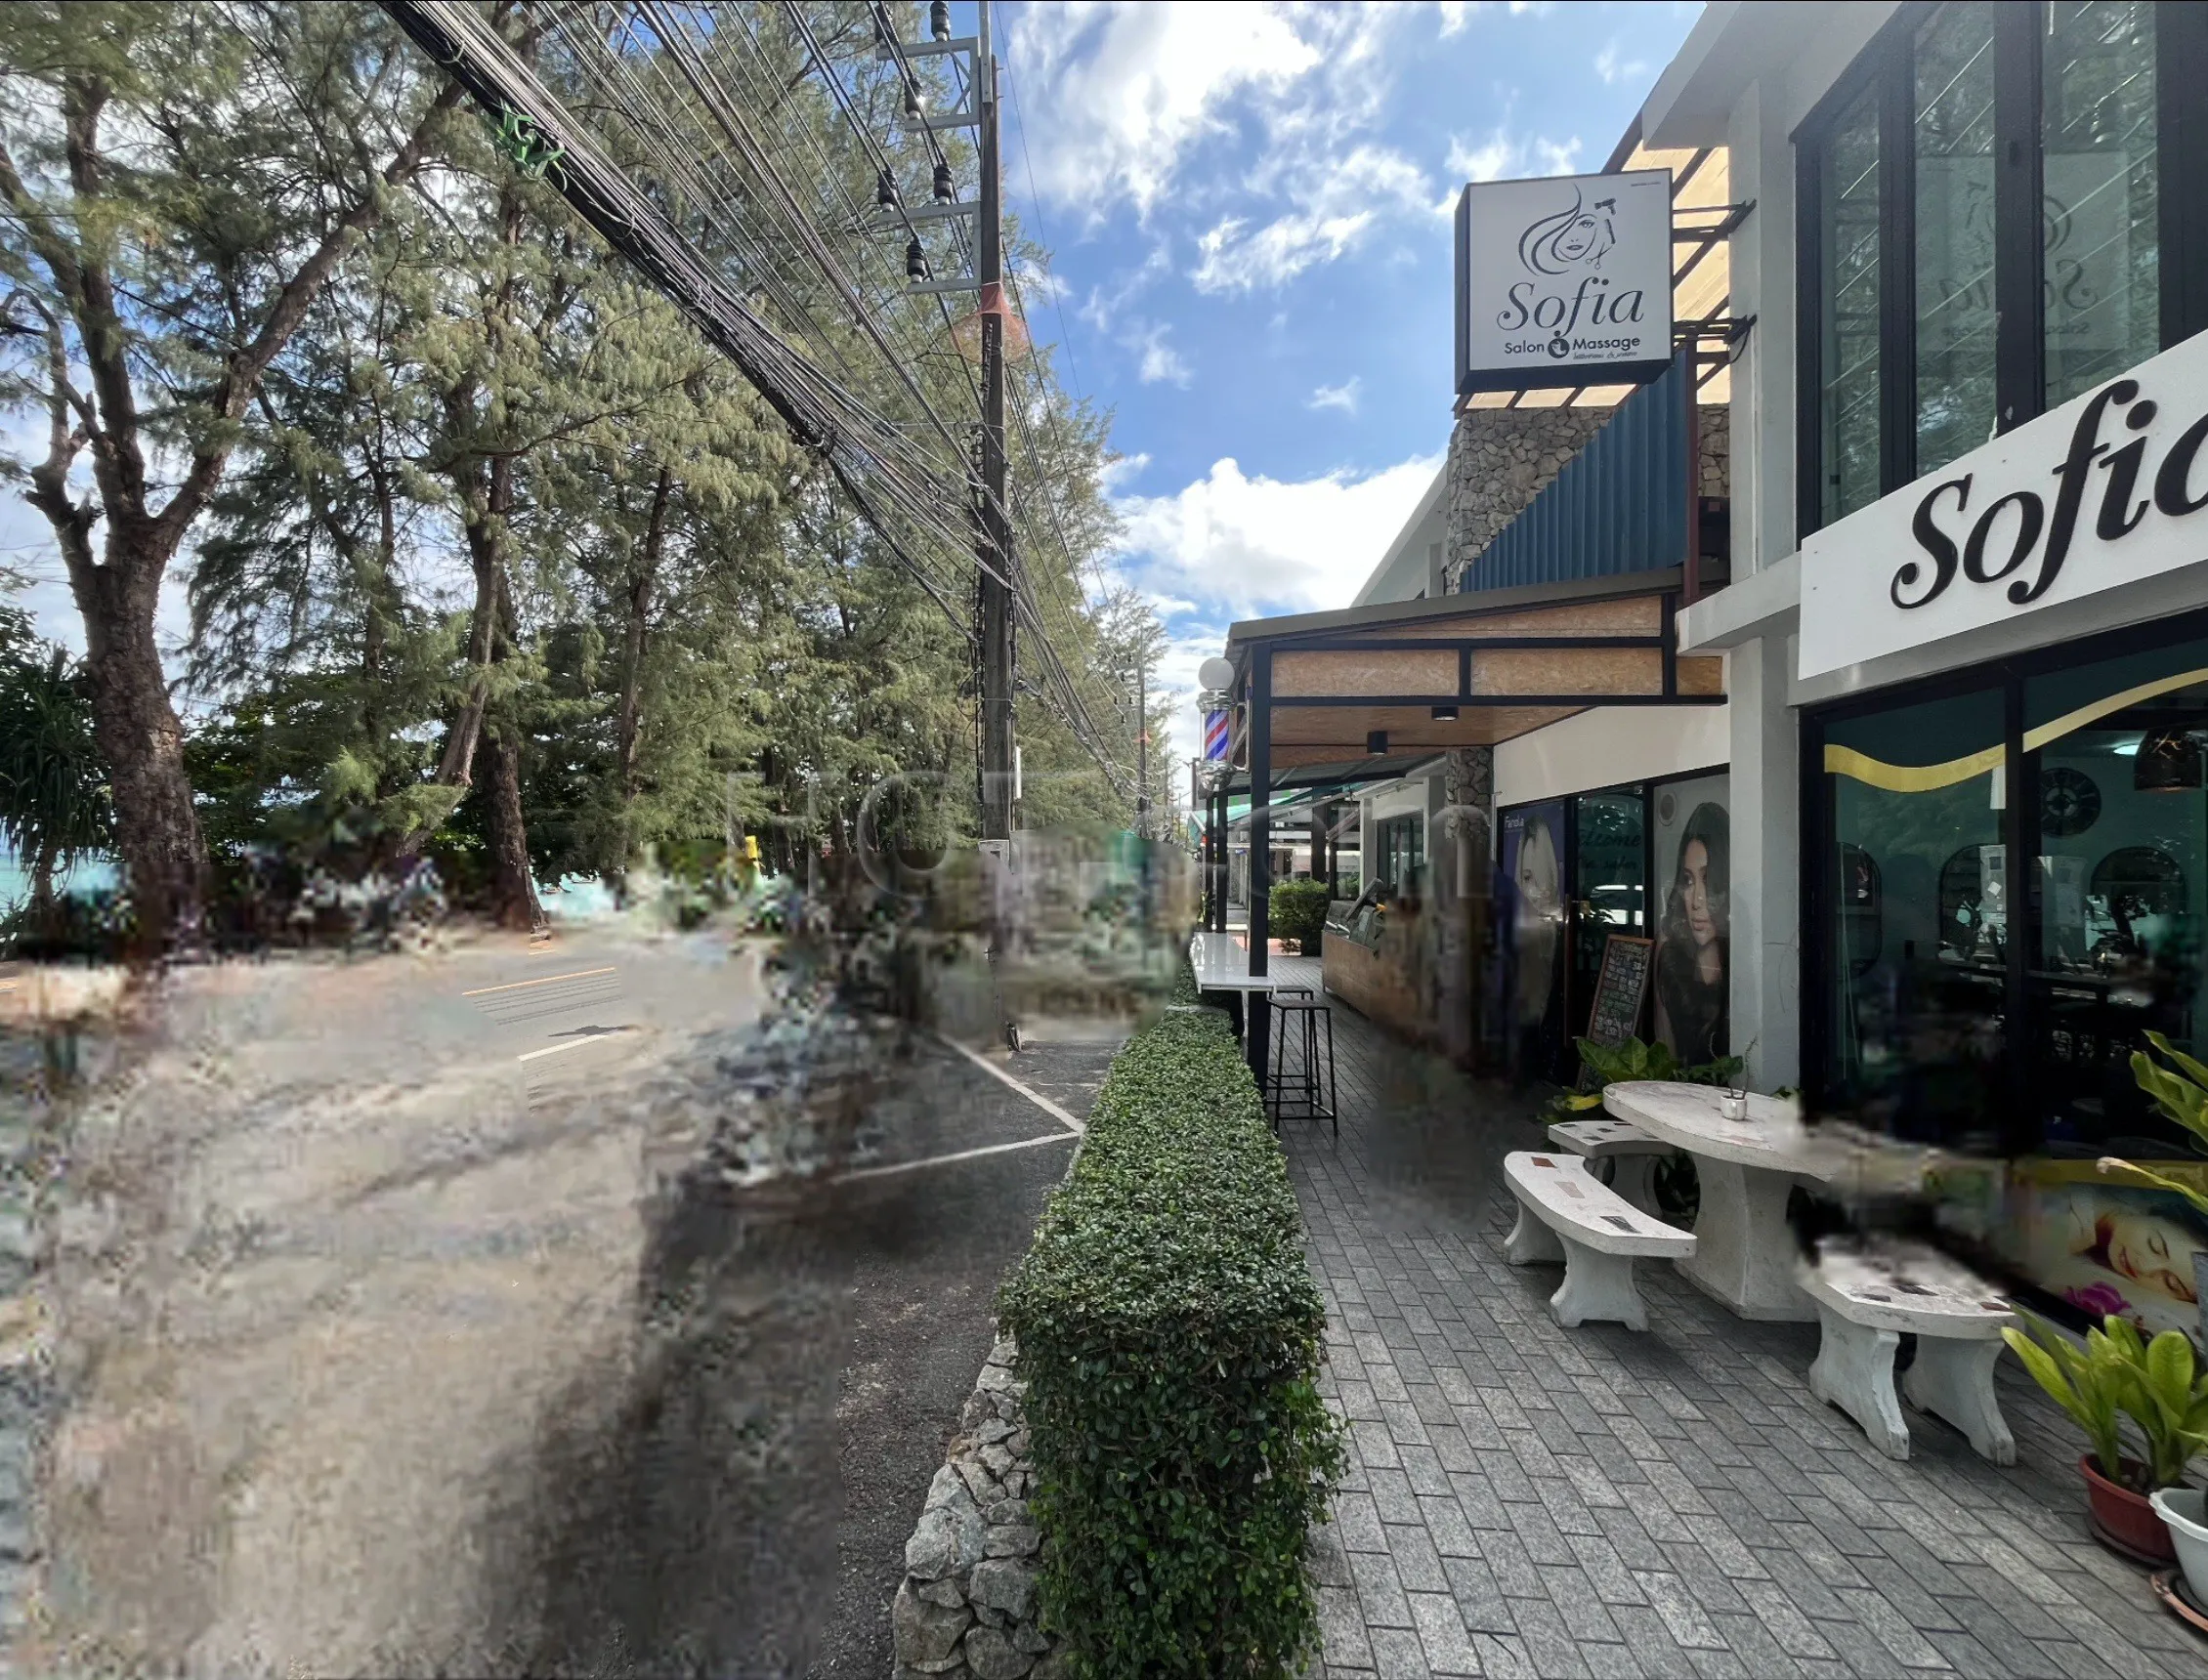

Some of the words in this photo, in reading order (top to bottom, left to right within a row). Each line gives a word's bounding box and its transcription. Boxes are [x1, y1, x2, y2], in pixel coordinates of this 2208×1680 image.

[1497, 276, 1644, 338] Sofia
[1505, 341, 1545, 355] Salon
[1572, 337, 1641, 351] Massage
